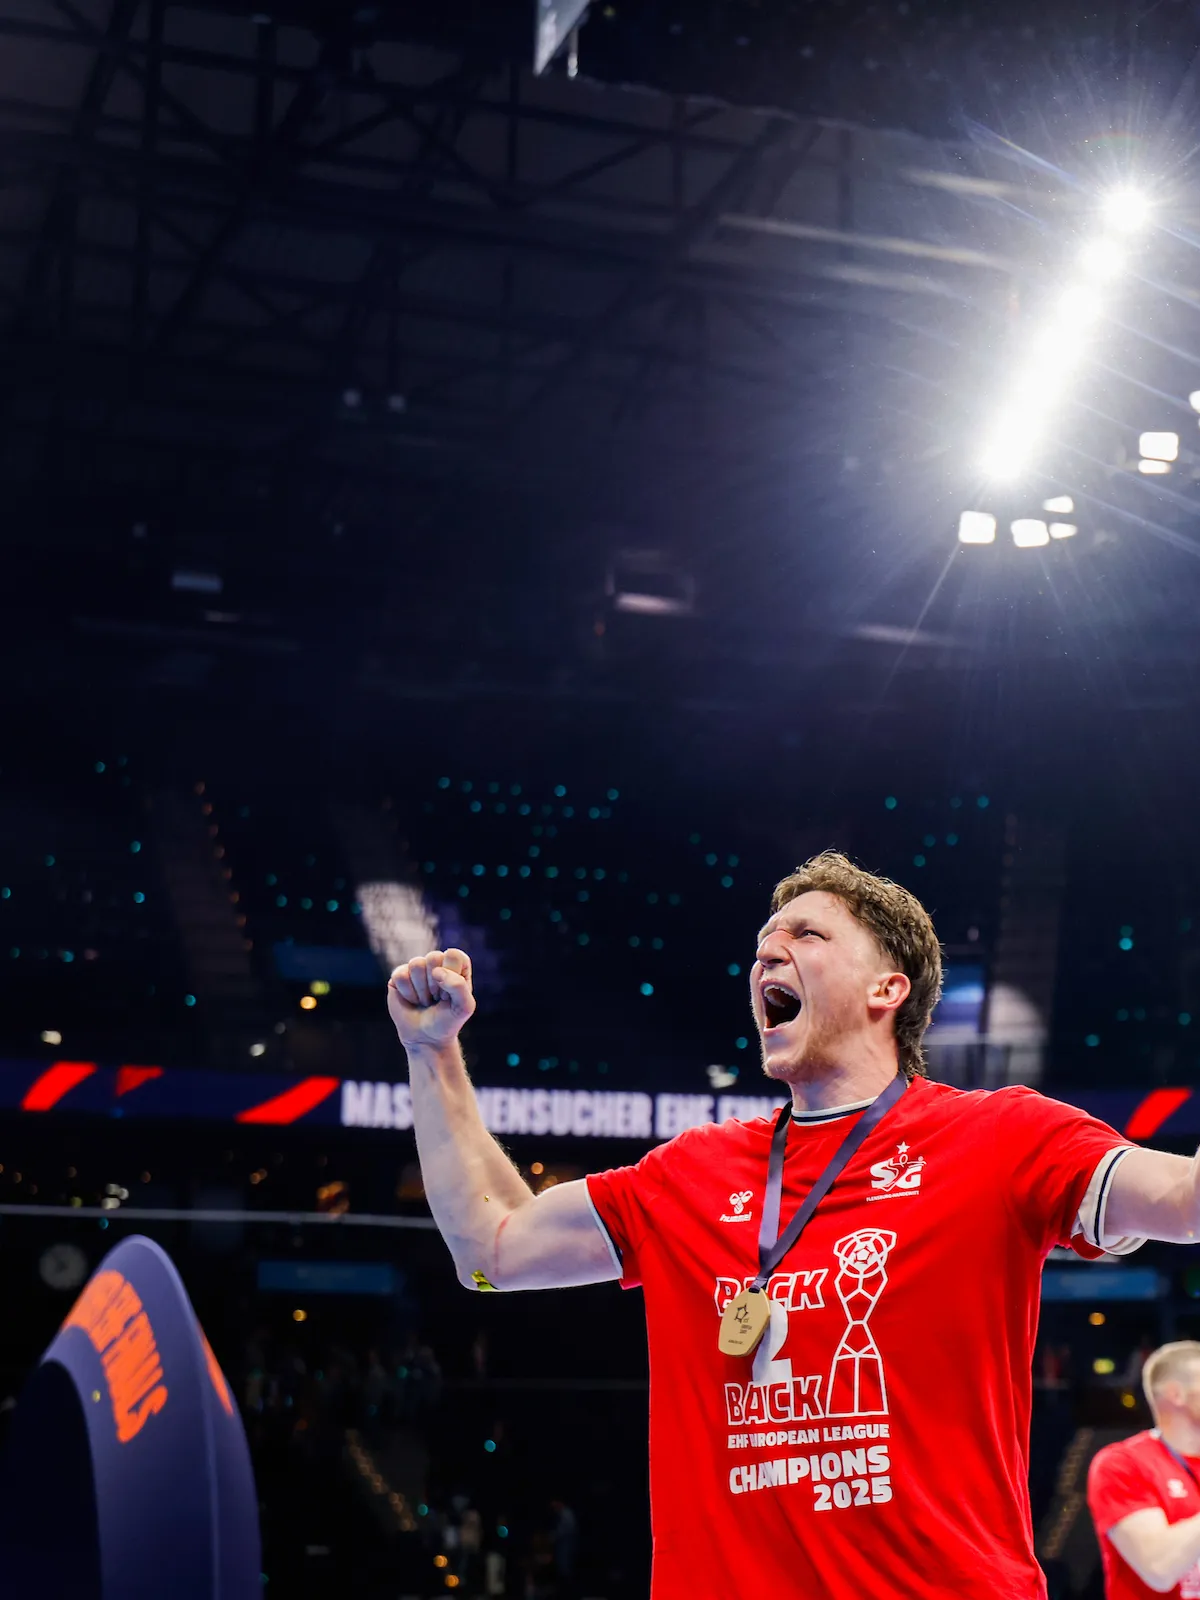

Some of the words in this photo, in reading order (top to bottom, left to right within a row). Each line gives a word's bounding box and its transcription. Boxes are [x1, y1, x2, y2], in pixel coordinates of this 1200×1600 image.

[719, 1211, 752, 1222] hummel
[714, 1268, 829, 1317] BCK
[724, 1375, 825, 1425] BACK
[823, 1423, 890, 1442] LEAGUE
[729, 1445, 891, 1494] CHAMPIONS
[813, 1475, 893, 1512] 2025
